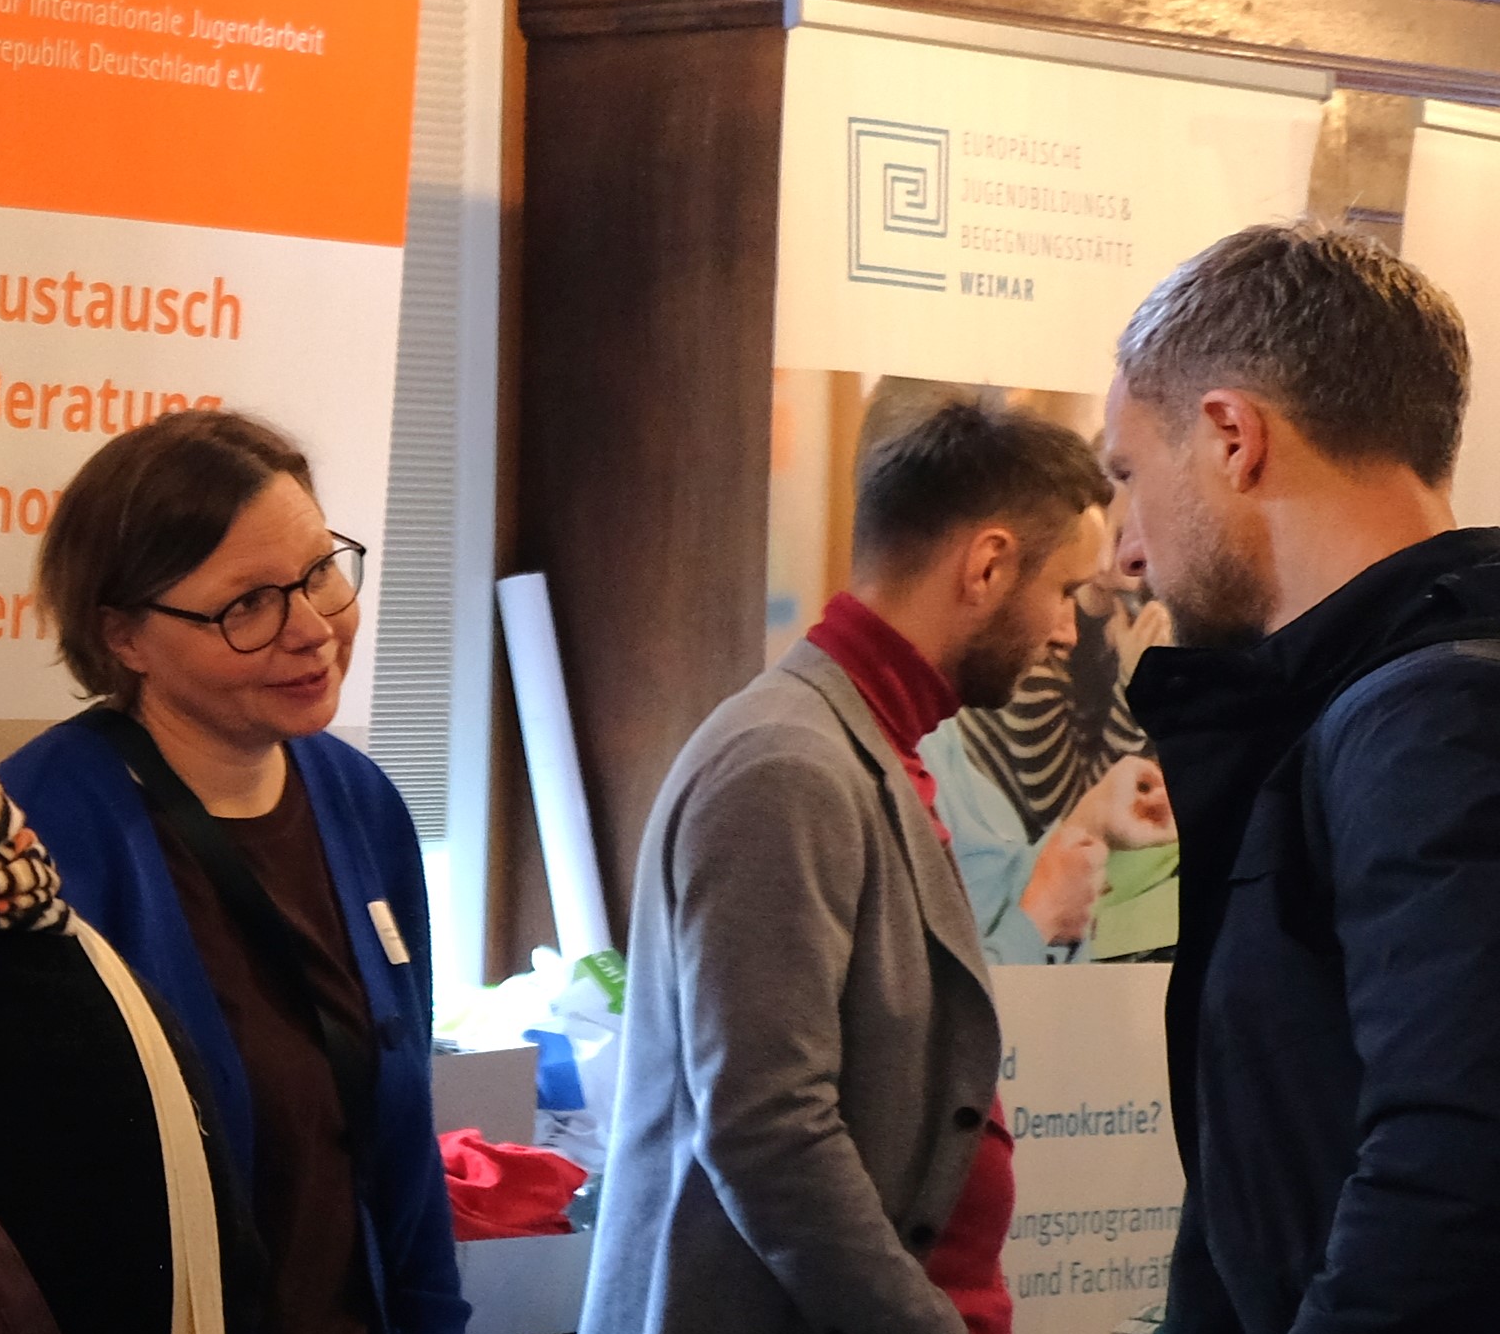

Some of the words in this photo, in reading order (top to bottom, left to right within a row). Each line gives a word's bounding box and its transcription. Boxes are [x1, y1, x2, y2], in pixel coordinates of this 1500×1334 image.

[189, 8, 325, 56] Jugendarbeit
[88, 43, 220, 90] Deutschland
[226, 63, 264, 95] e.V.
[962, 130, 1082, 170] EUROPÄISCHE
[960, 225, 1133, 268] BEGEGNUNGSSTÄTTE
[959, 273, 1034, 302] WEIMAR
[1014, 1100, 1161, 1140] Demokratie?
[1019, 1261, 1062, 1299] und
[1070, 1255, 1171, 1295] Fachkräf
